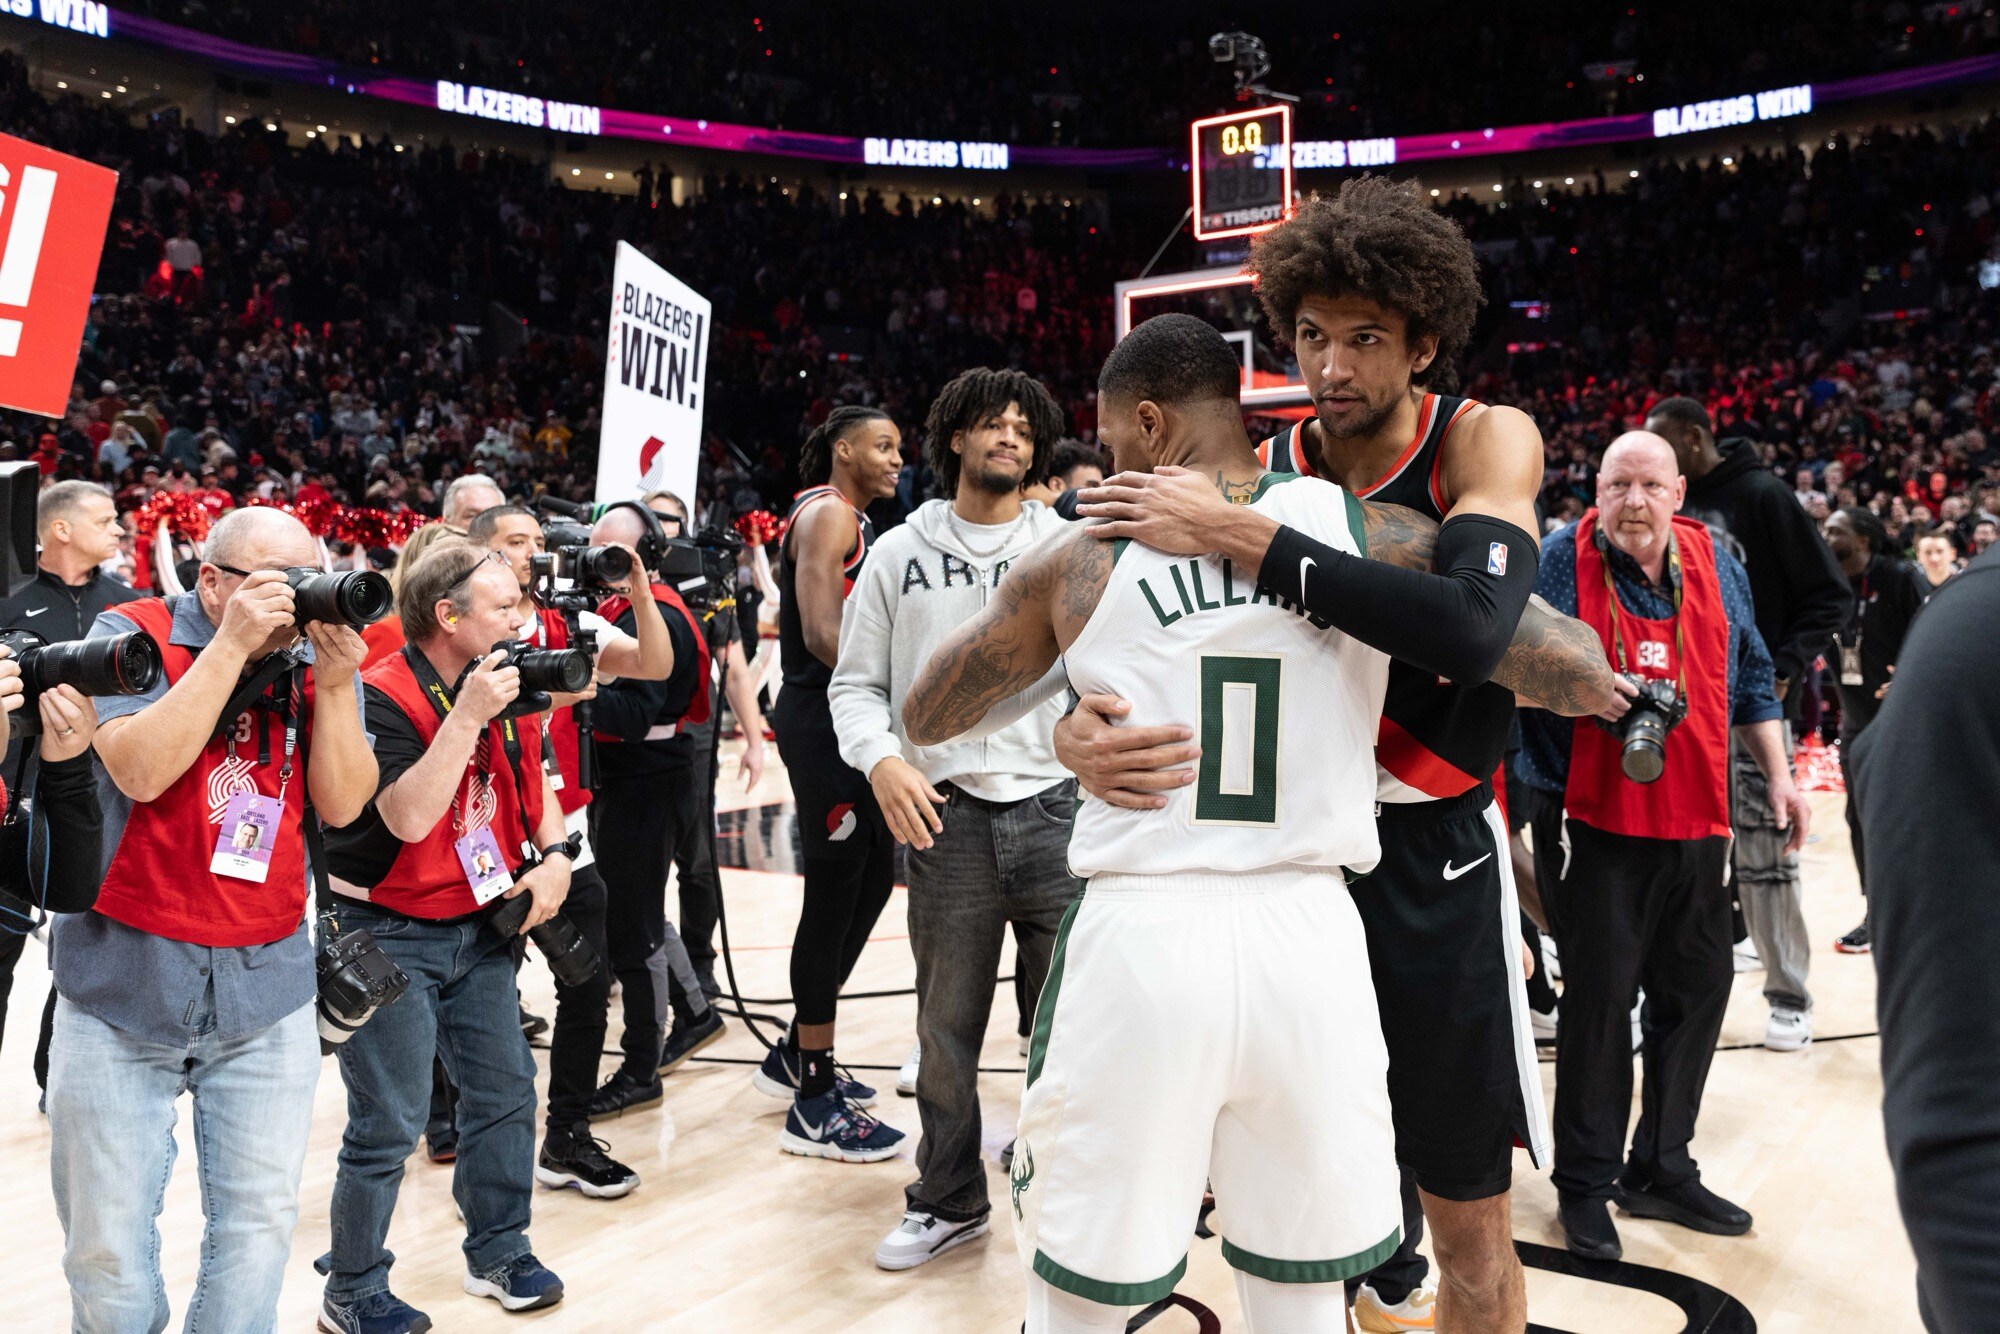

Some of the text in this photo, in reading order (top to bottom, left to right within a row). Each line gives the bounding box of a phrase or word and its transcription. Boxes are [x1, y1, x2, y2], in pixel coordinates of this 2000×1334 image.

[39, 0, 108, 38] WIN
[437, 79, 600, 135] BLAZERS WIN
[1653, 84, 1812, 138] BLAZERS WIN
[864, 137, 1009, 169] BLAZERS WIN
[1222, 122, 1262, 155] 0.0
[1347, 138, 1395, 166] WIN
[1223, 204, 1282, 226] TISSOT
[623, 282, 692, 340] BLAZERS
[1137, 558, 1332, 630] LILLA
[1638, 640, 1669, 670] 32
[1190, 650, 1286, 829] 0
